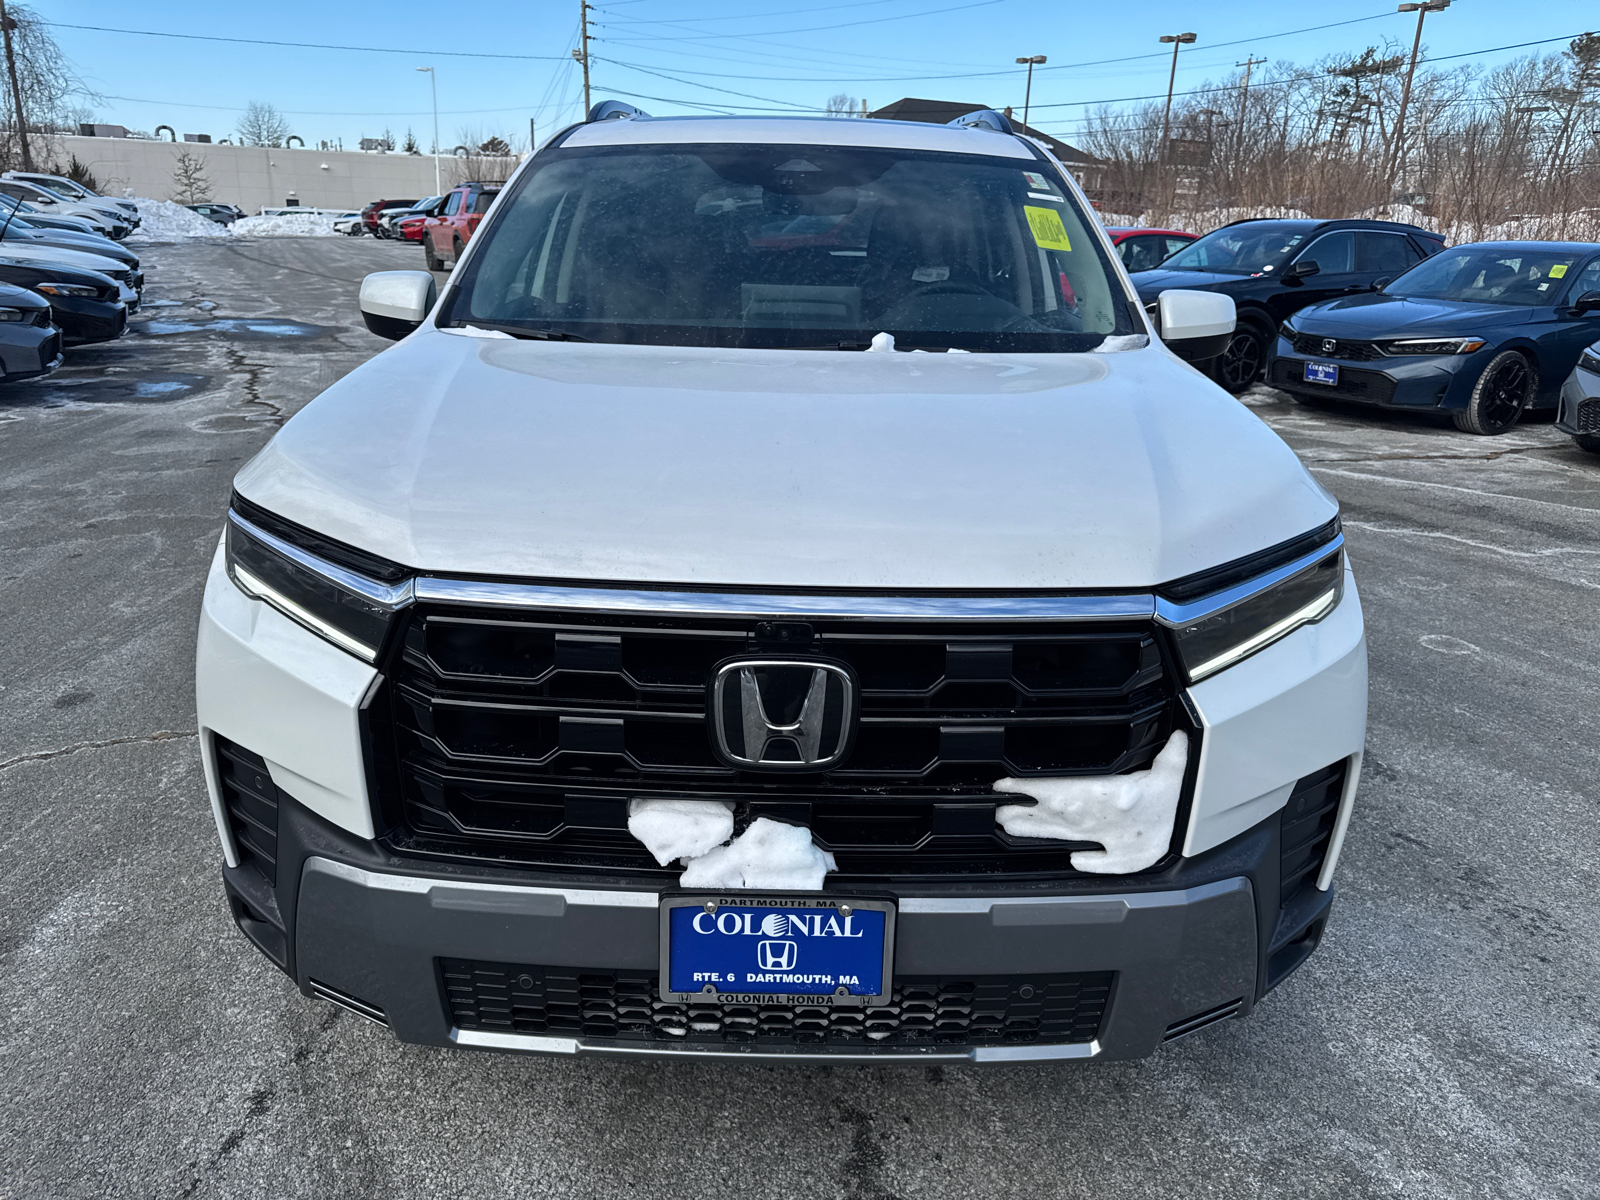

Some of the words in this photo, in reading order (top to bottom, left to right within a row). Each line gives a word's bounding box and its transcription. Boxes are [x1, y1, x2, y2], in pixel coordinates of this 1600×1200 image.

[815, 900, 837, 908] MA
[692, 911, 864, 938] COLONIAL
[693, 972, 723, 982] RTE.
[726, 973, 735, 982] 6
[746, 973, 835, 985] DARTMOUTH,
[838, 975, 860, 985] MA
[717, 994, 783, 1004] COLONIAL
[786, 995, 834, 1005] HONDA
